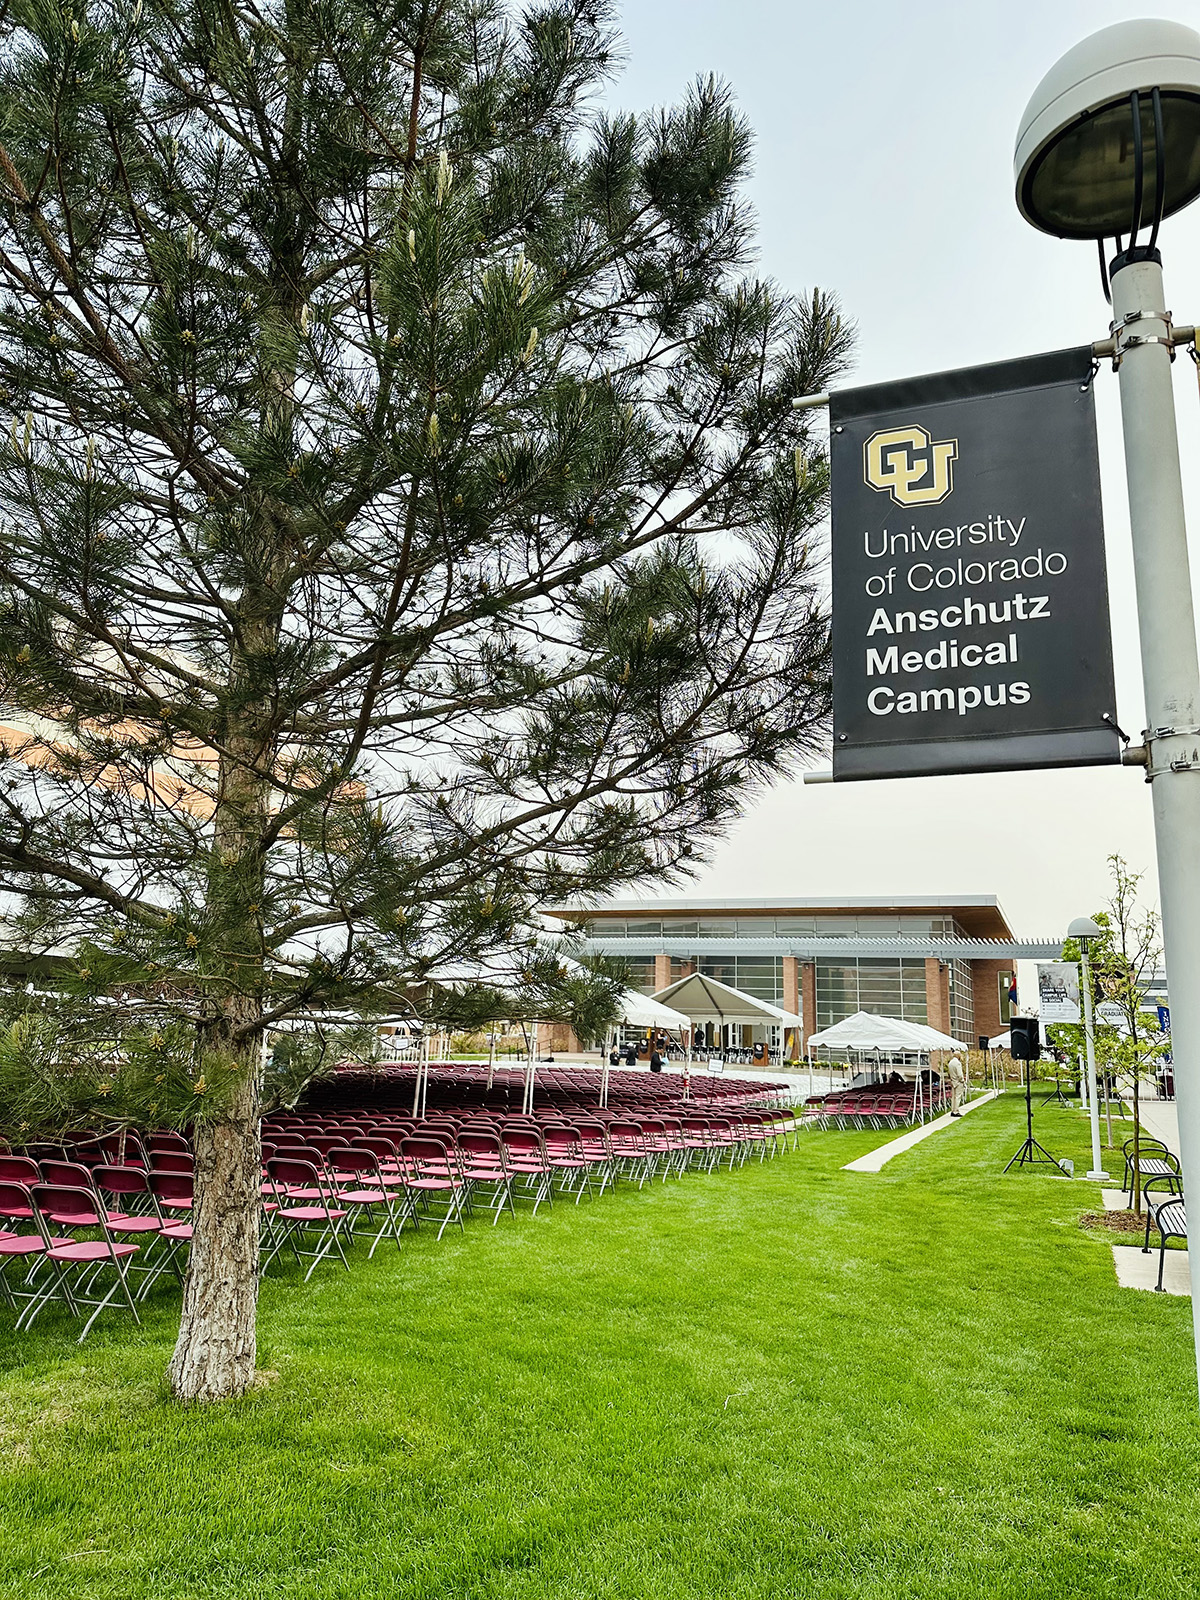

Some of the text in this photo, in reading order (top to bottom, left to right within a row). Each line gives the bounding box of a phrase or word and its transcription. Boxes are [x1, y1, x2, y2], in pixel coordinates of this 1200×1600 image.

[864, 514, 1026, 558] University
[864, 548, 1067, 597] of Colorado
[866, 593, 1051, 637] Anschutz
[865, 633, 1019, 676] Medical
[866, 680, 1031, 716] Campus
